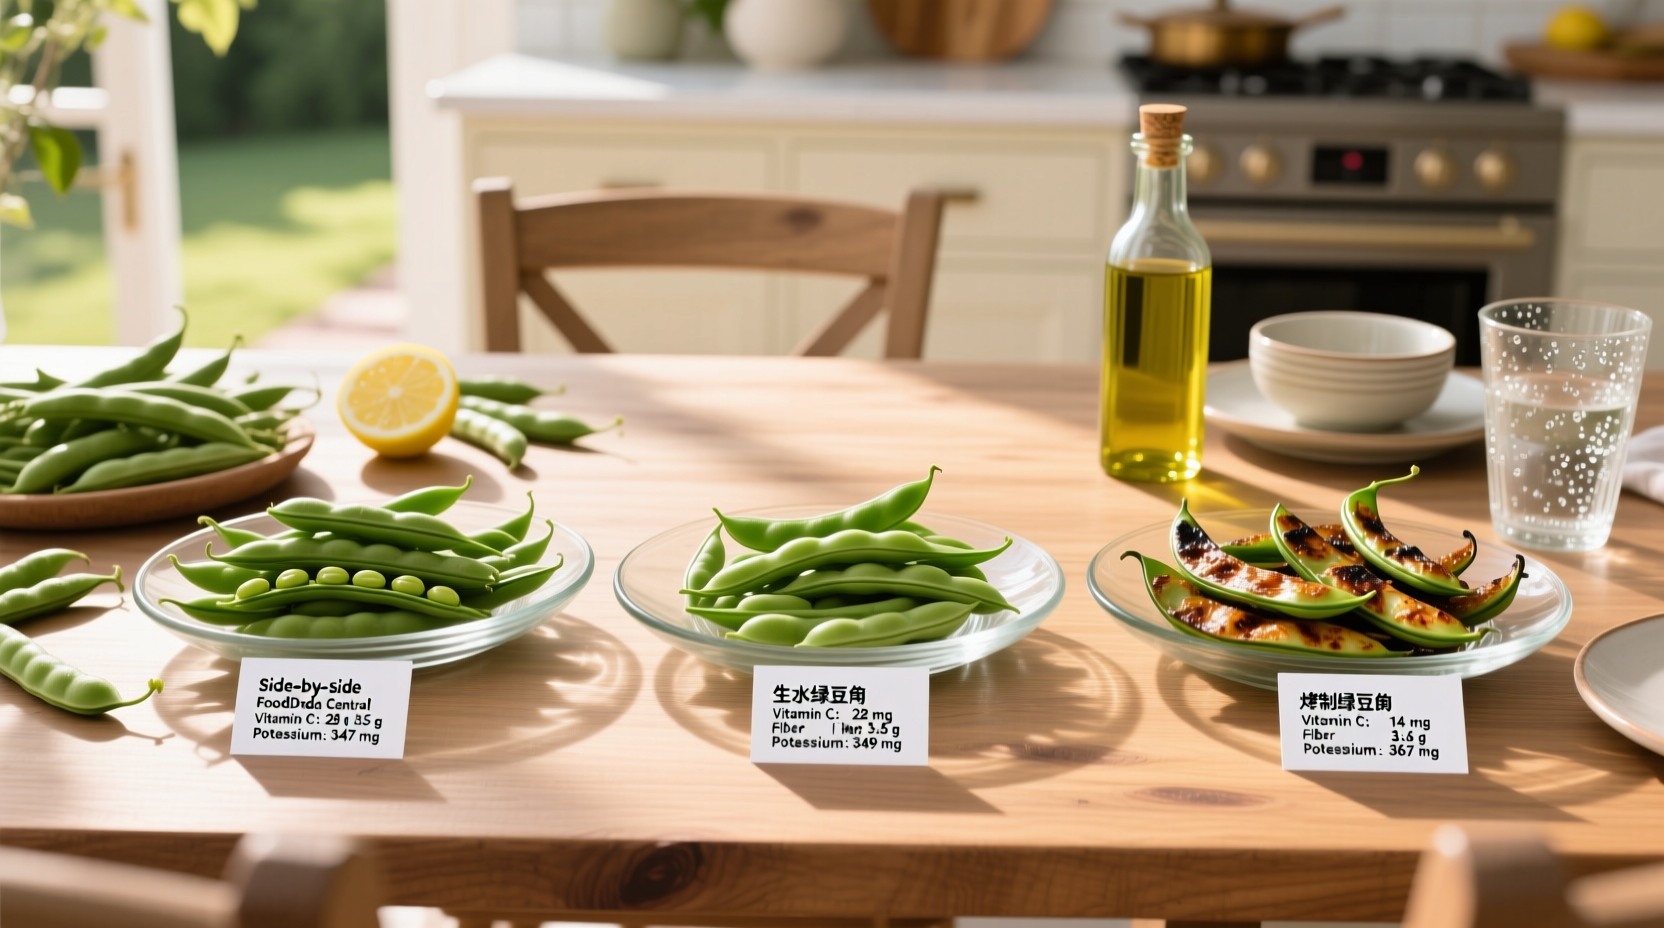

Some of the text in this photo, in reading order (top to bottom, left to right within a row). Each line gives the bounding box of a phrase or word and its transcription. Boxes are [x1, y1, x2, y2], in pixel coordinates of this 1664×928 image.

[259, 677, 361, 698] Side-by-side
[326, 698, 372, 711] Central
[305, 713, 320, 724] C:
[374, 718, 382, 729] g
[773, 708, 893, 724] Vitamin C: 22 mg
[1355, 716, 1369, 727] C:
[1389, 716, 1405, 728] 14
[1410, 719, 1430, 731] mg
[331, 728, 356, 741] 347
[359, 732, 380, 745] mg
[892, 726, 900, 738] g
[1418, 734, 1426, 746] g
[852, 737, 878, 749] 349
[881, 740, 902, 753] mg
[1389, 744, 1415, 757] 367
[1419, 748, 1439, 761] mg
